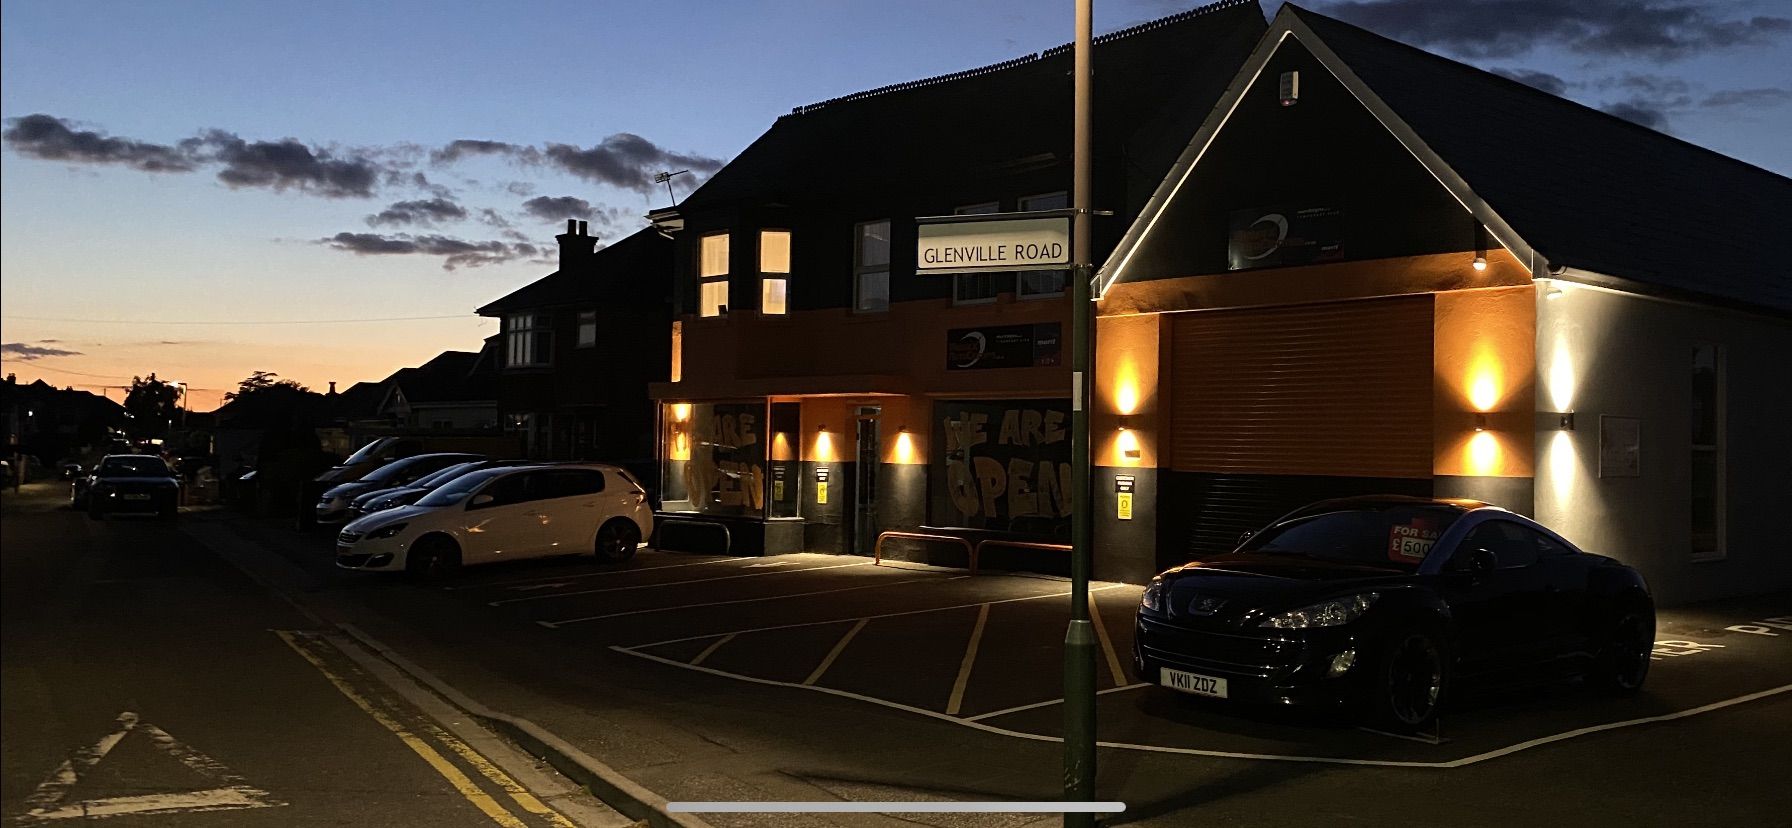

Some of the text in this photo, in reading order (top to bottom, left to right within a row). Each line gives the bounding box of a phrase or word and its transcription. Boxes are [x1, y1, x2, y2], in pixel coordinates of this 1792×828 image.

[924, 242, 1062, 264] GLENVILLE ROAD
[998, 408, 1066, 448] ARE
[946, 456, 1073, 519] OPEN
[1393, 525, 1439, 539] FOR SA
[1193, 676, 1218, 694] ZDZ
